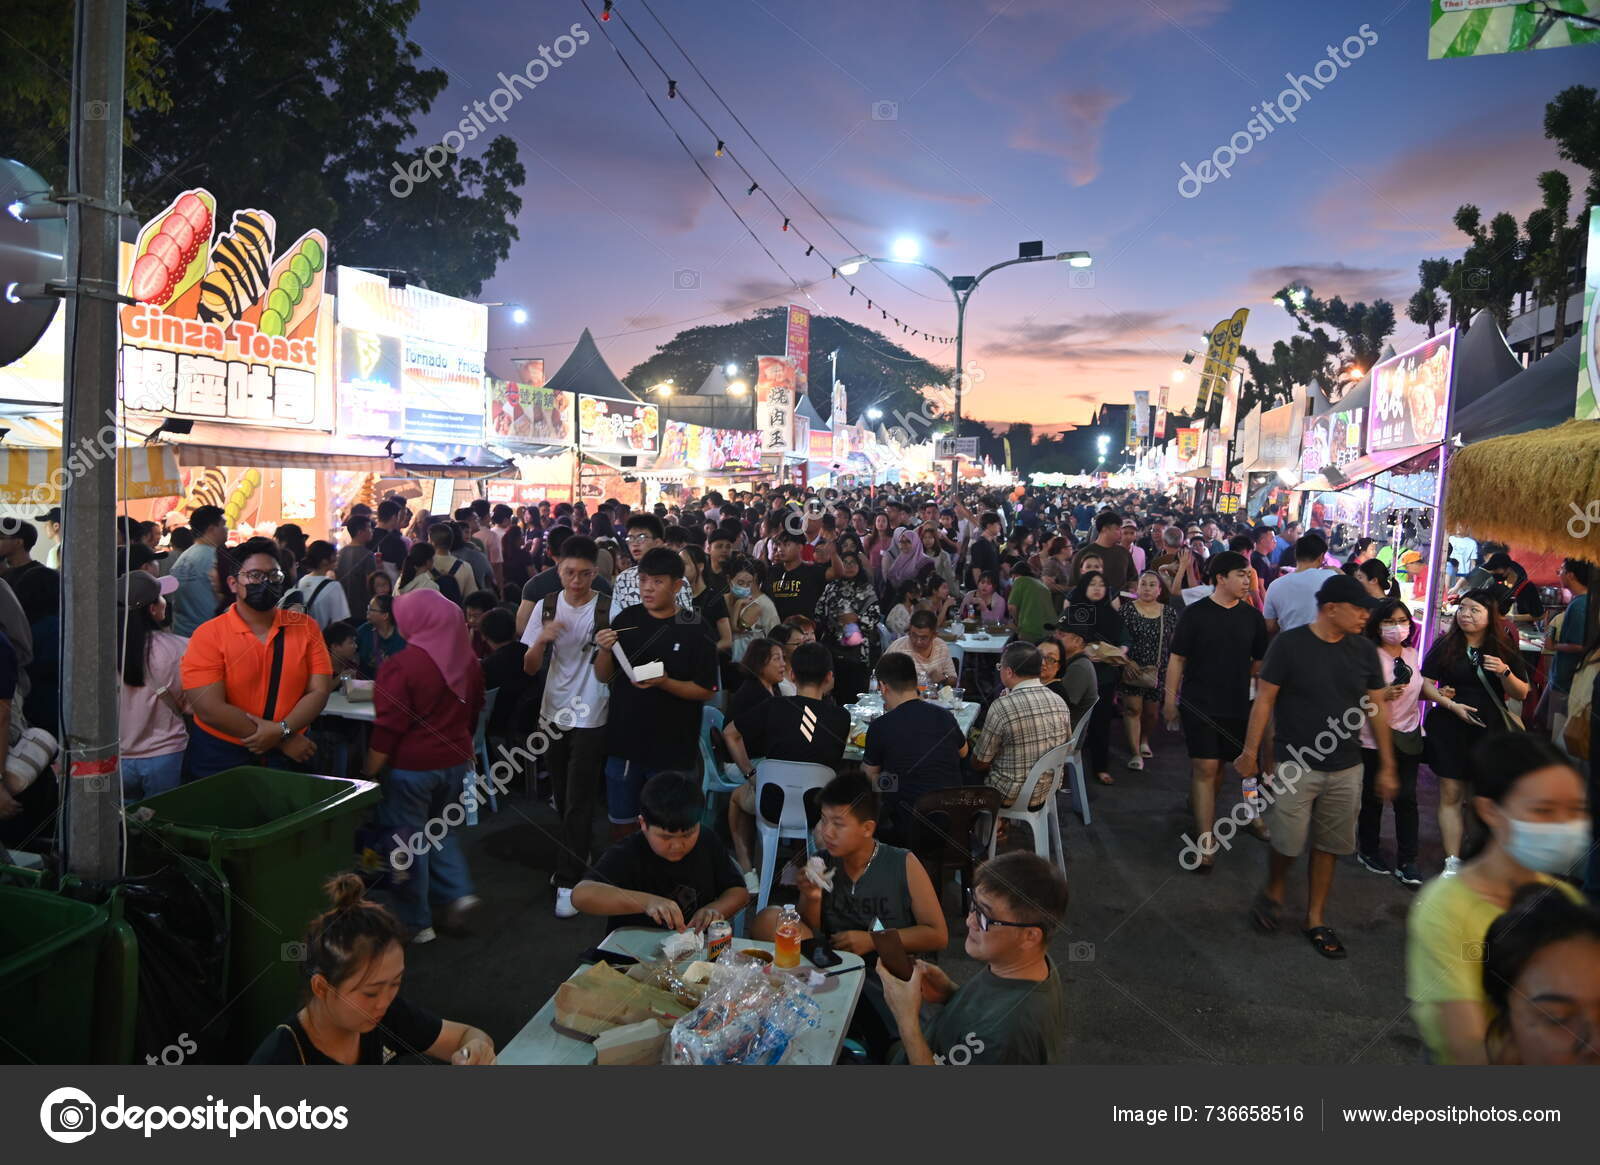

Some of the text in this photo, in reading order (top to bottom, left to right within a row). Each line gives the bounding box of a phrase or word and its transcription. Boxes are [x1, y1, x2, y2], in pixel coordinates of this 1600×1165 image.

[121, 304, 317, 367] Ginza Toast
[405, 347, 448, 369] Tornado
